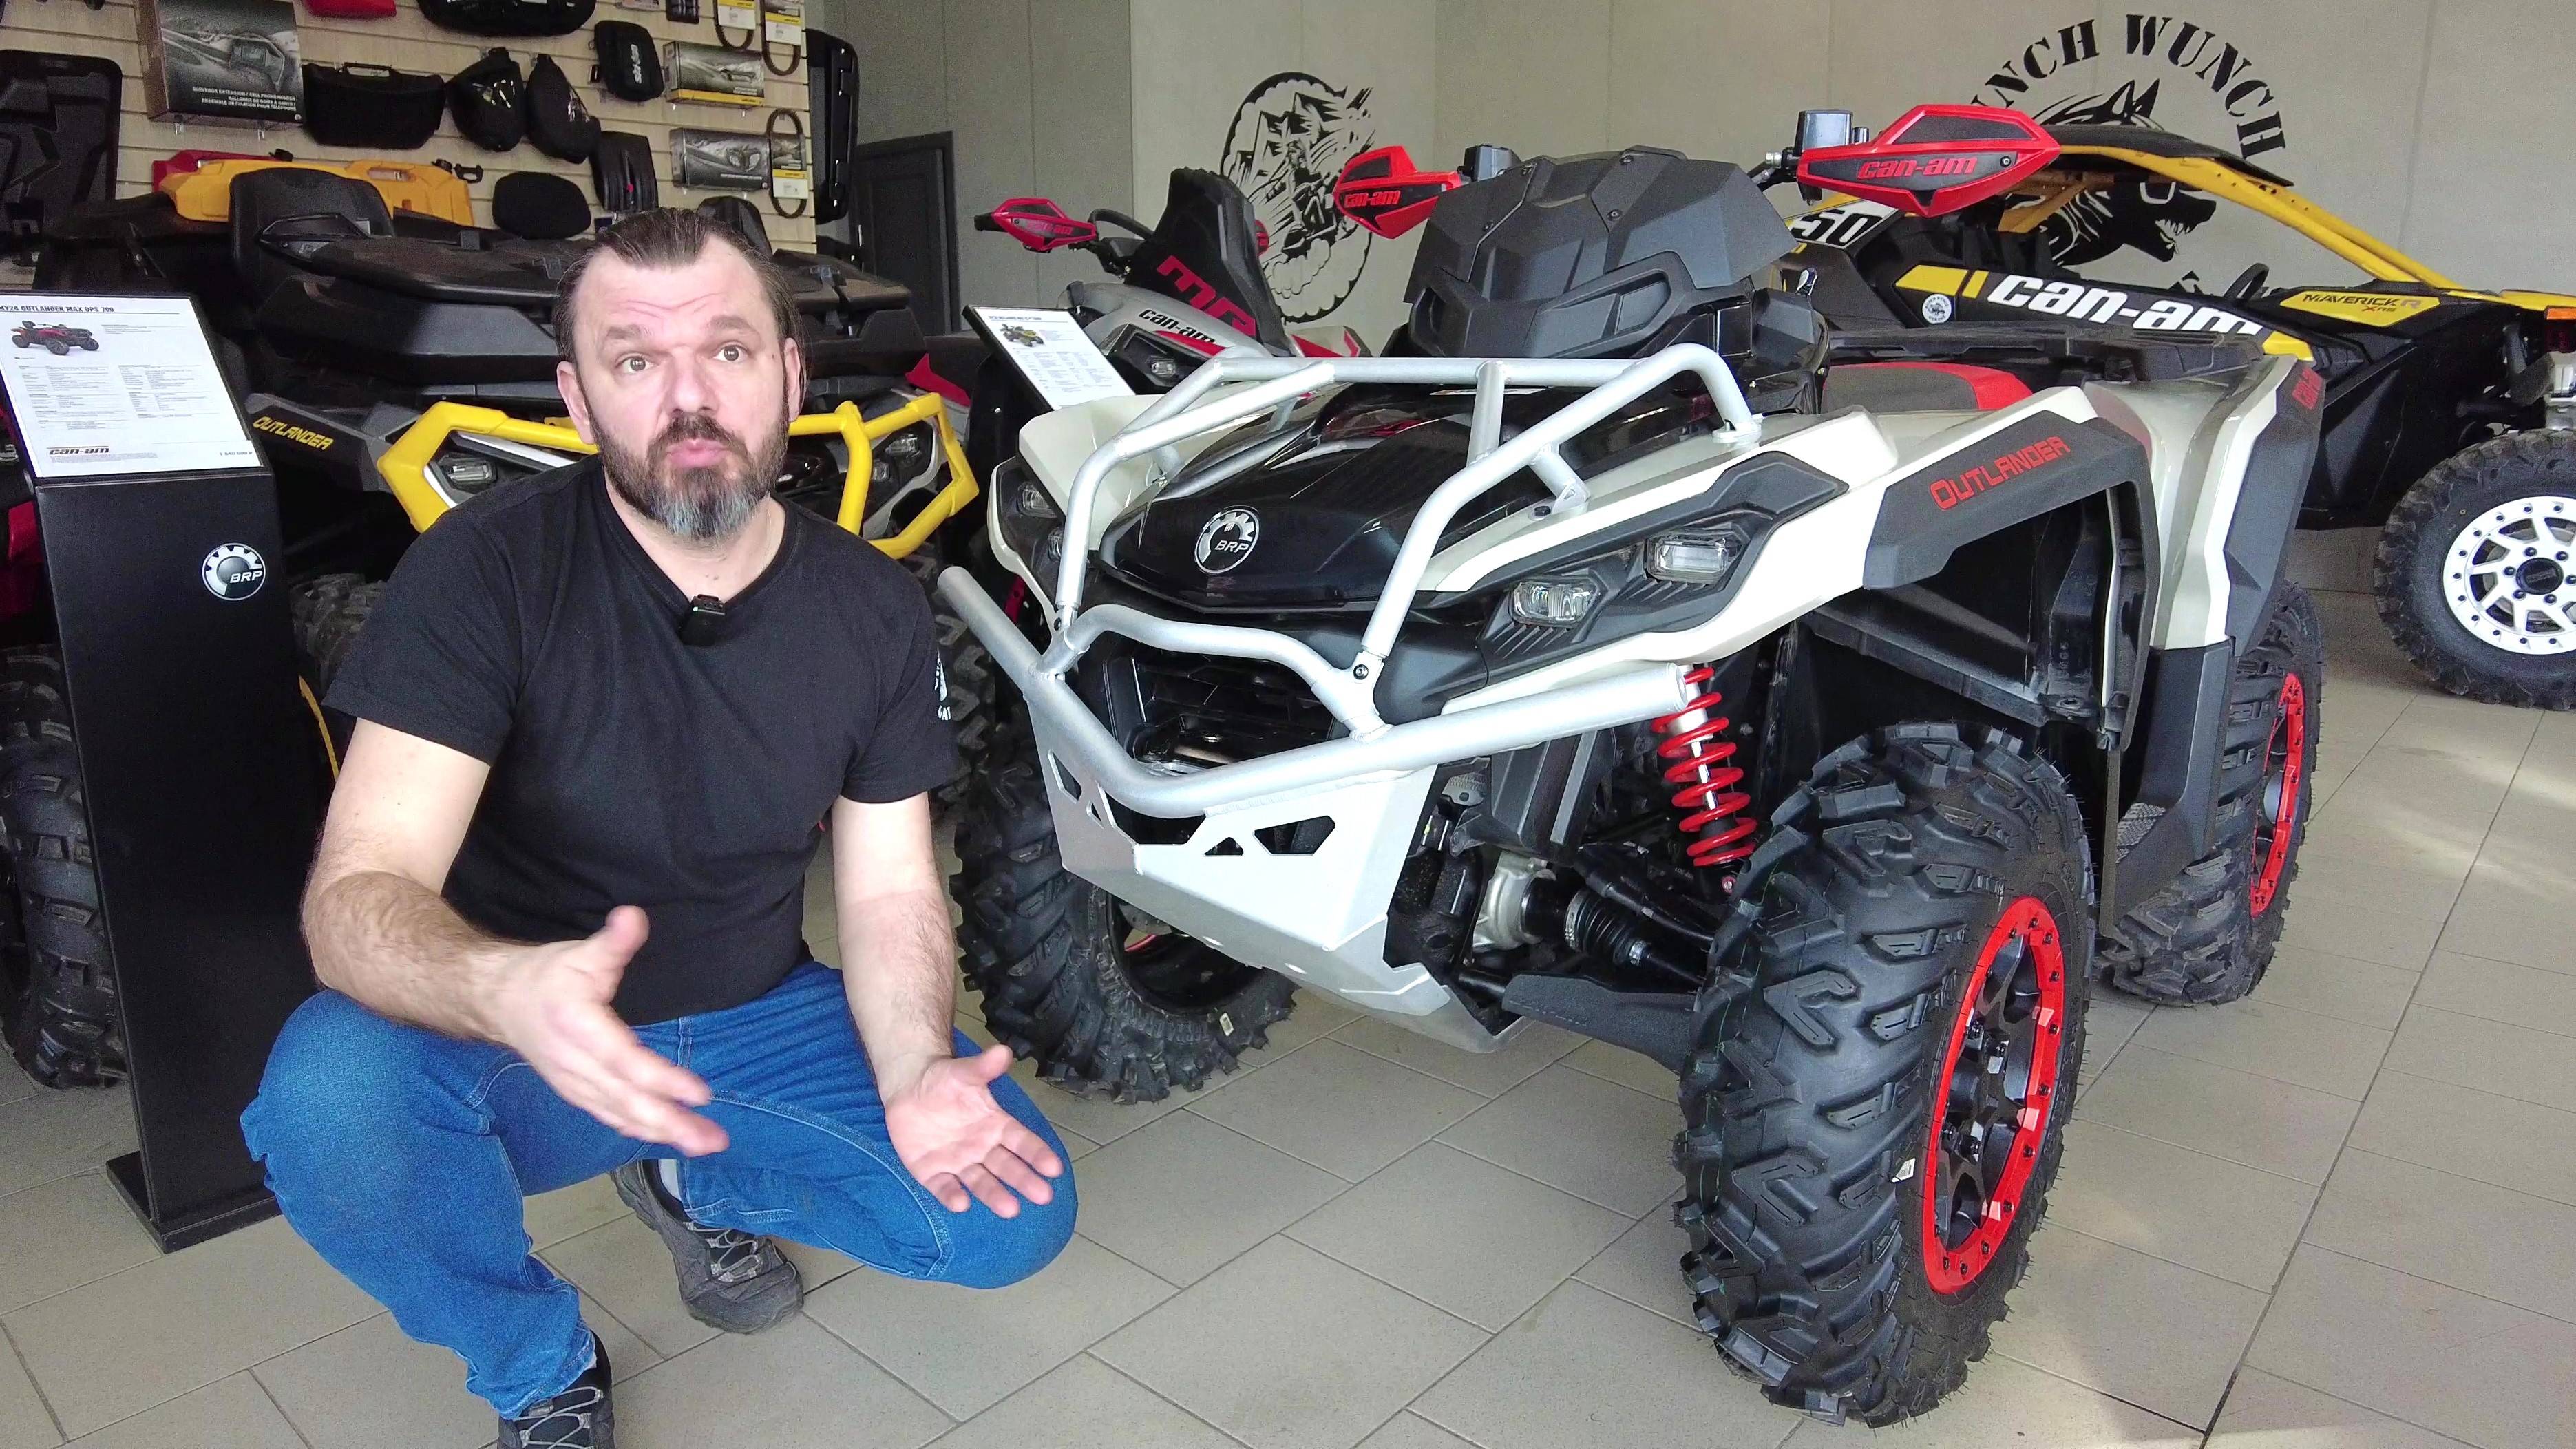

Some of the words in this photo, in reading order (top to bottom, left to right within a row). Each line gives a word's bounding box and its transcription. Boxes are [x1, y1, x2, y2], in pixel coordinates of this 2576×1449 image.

[2126, 14, 2286, 159] WUNCH
[1858, 157, 1978, 180] can-am
[1344, 190, 1401, 208] can-am
[1987, 274, 2263, 335] can-am
[2303, 295, 2400, 306] MAVERICK
[1138, 309, 1216, 343] can-am
[253, 416, 335, 451] OUTLANDER
[49, 447, 110, 456] can-am
[1930, 436, 2071, 510] OUTLANDER
[1214, 540, 1249, 553] BRP
[229, 570, 264, 584] BRP
